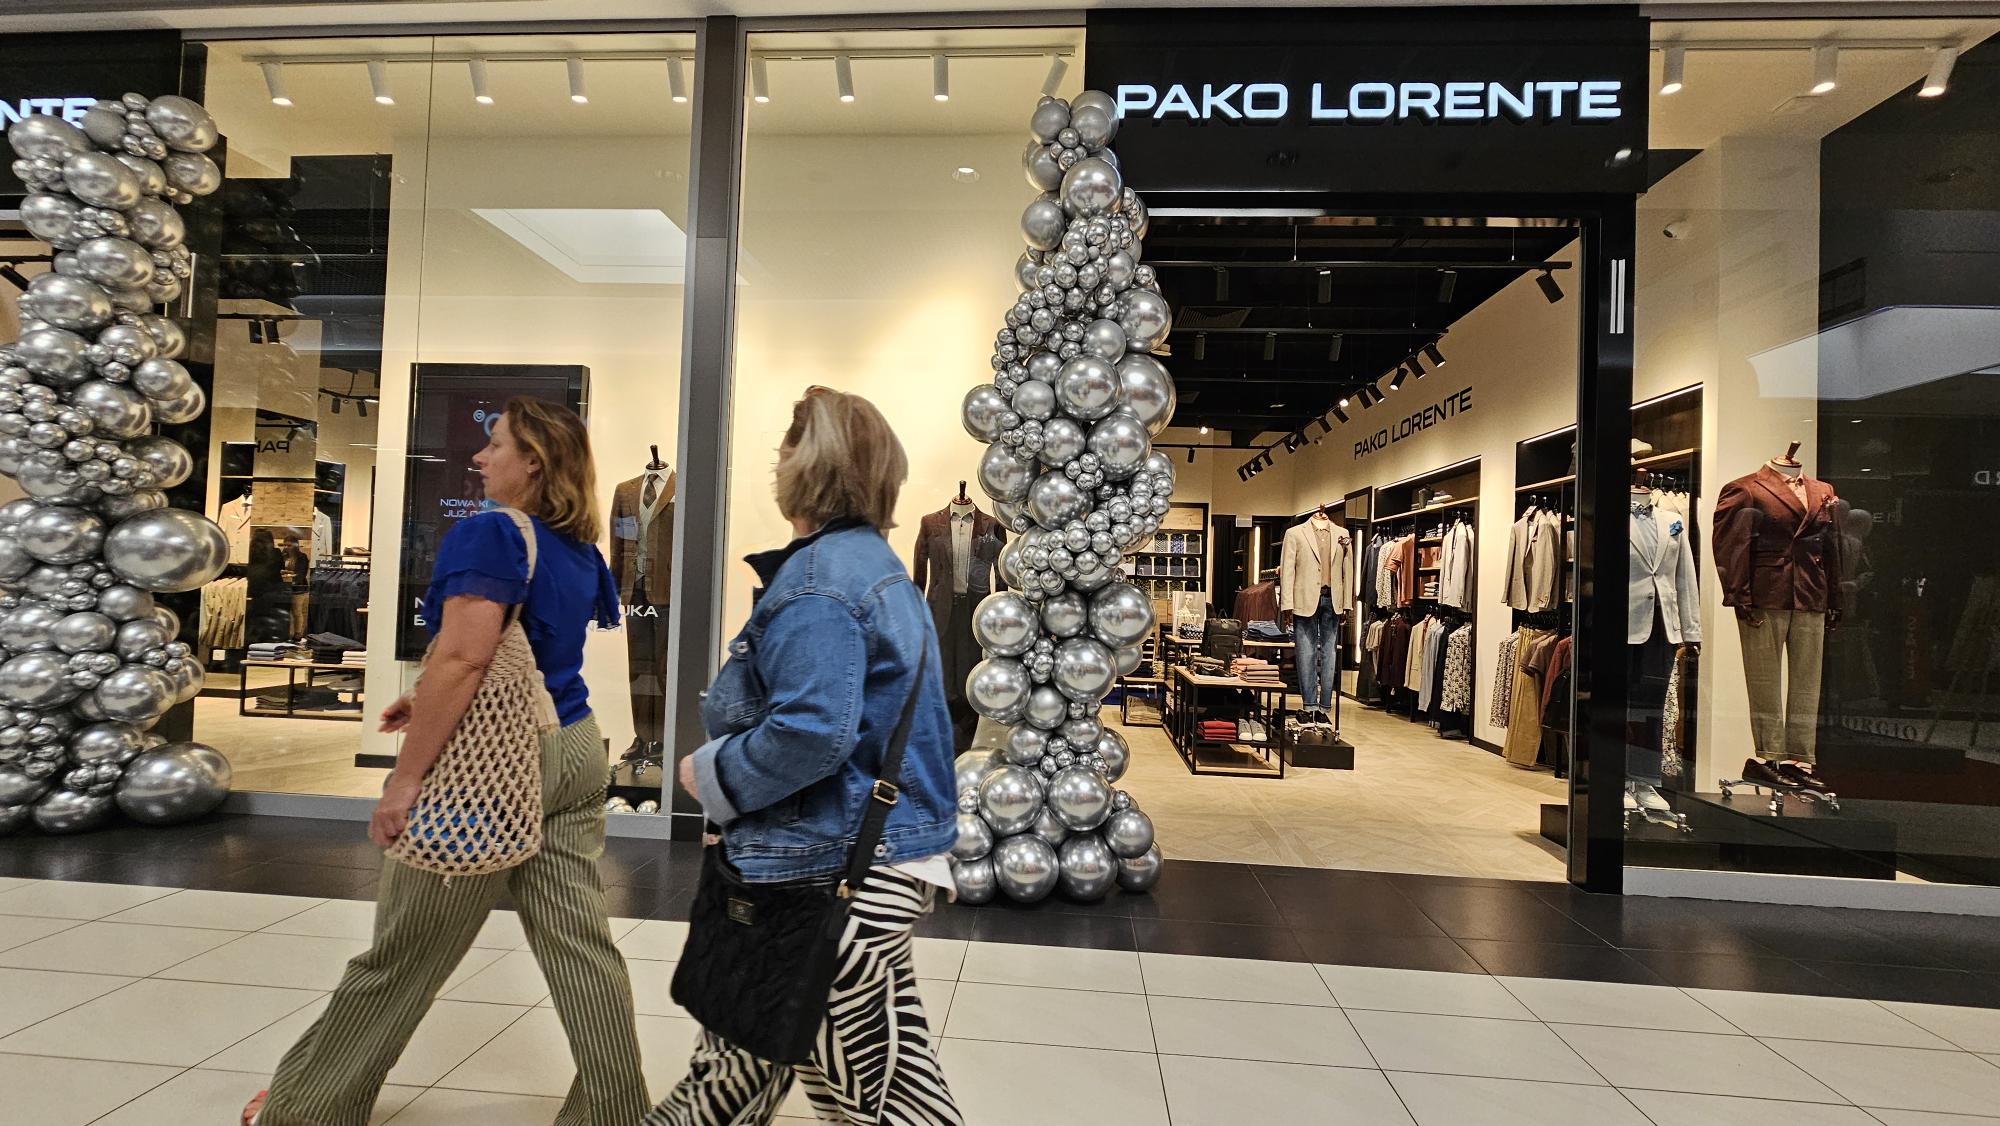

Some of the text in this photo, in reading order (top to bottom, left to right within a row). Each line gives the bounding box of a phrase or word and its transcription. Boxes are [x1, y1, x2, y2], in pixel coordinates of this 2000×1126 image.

[1117, 81, 1622, 119] PAKO LORENTE
[1354, 386, 1473, 461] PAKO LORENTE
[440, 498, 475, 508] NOWA
